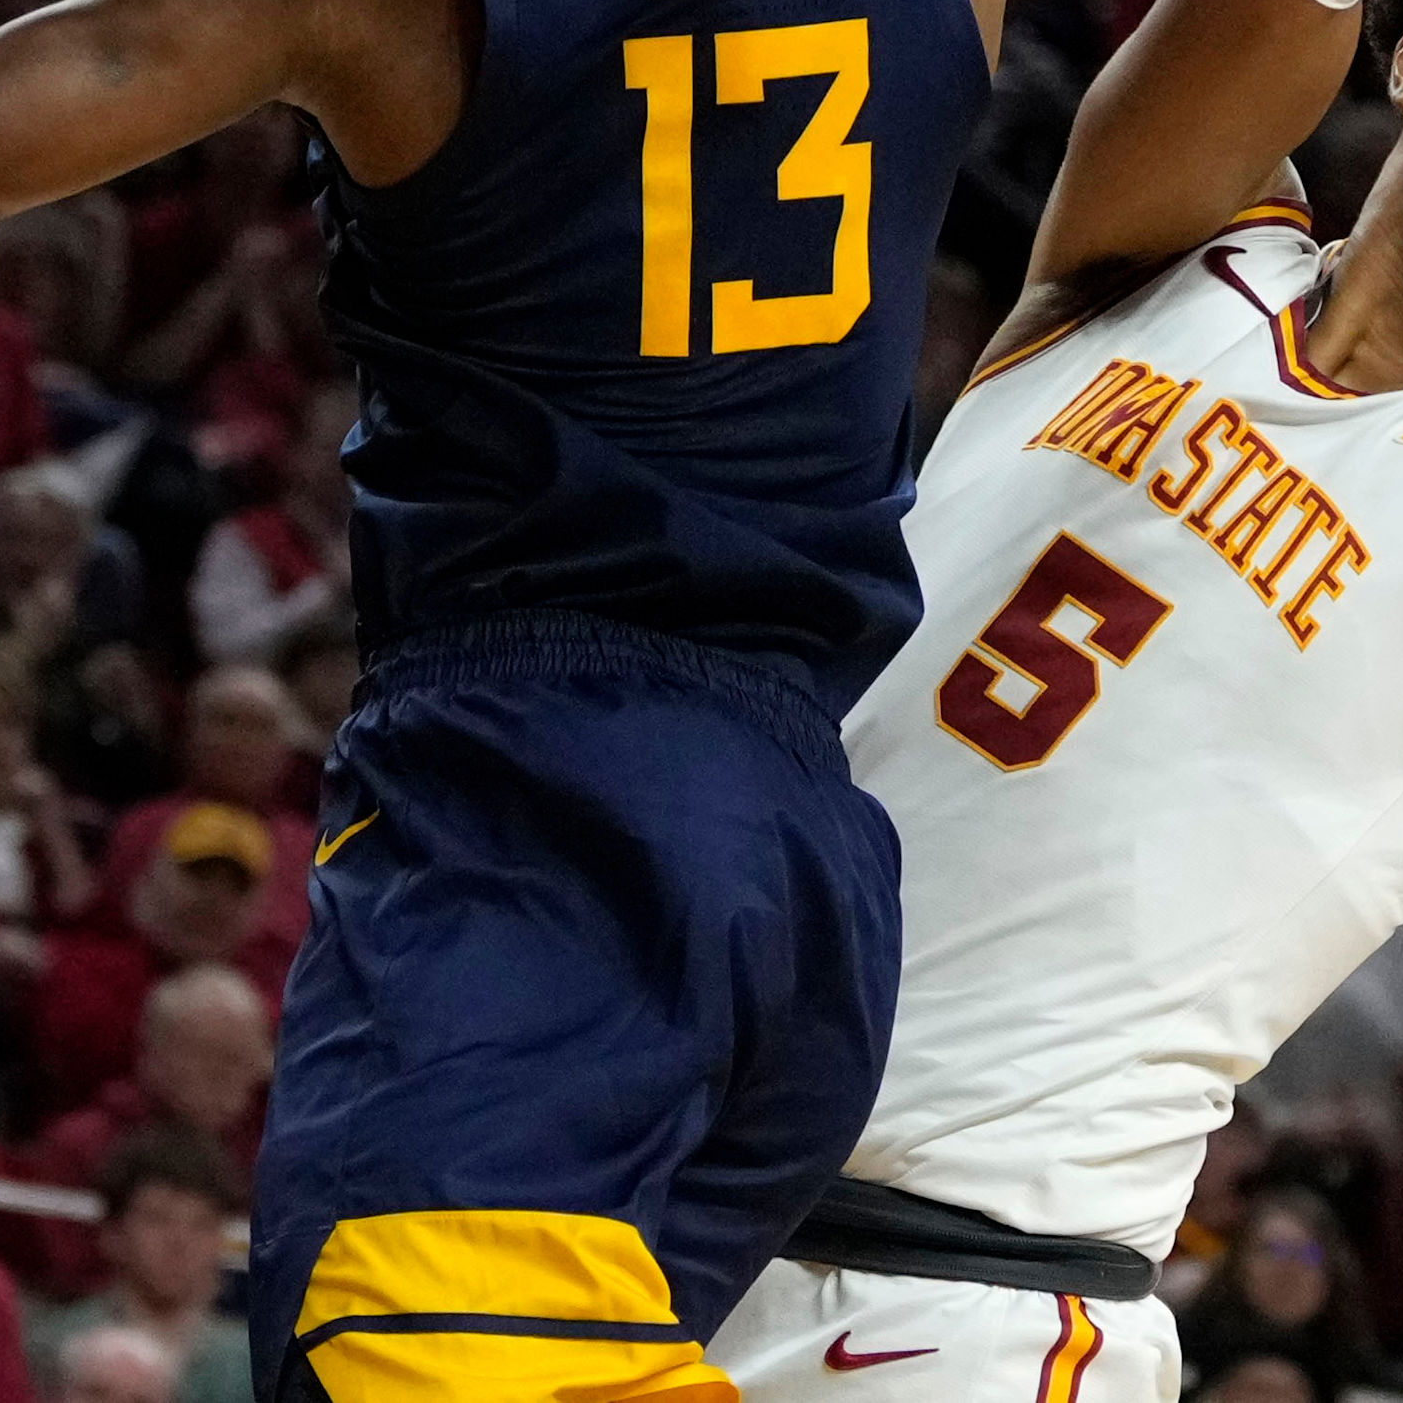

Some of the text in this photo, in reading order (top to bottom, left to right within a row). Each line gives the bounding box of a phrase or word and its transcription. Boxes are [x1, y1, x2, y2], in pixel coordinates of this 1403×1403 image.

[623, 18, 872, 357] 13
[935, 529, 1175, 773] 5
[1022, 357, 1372, 653] IOWA STATE
